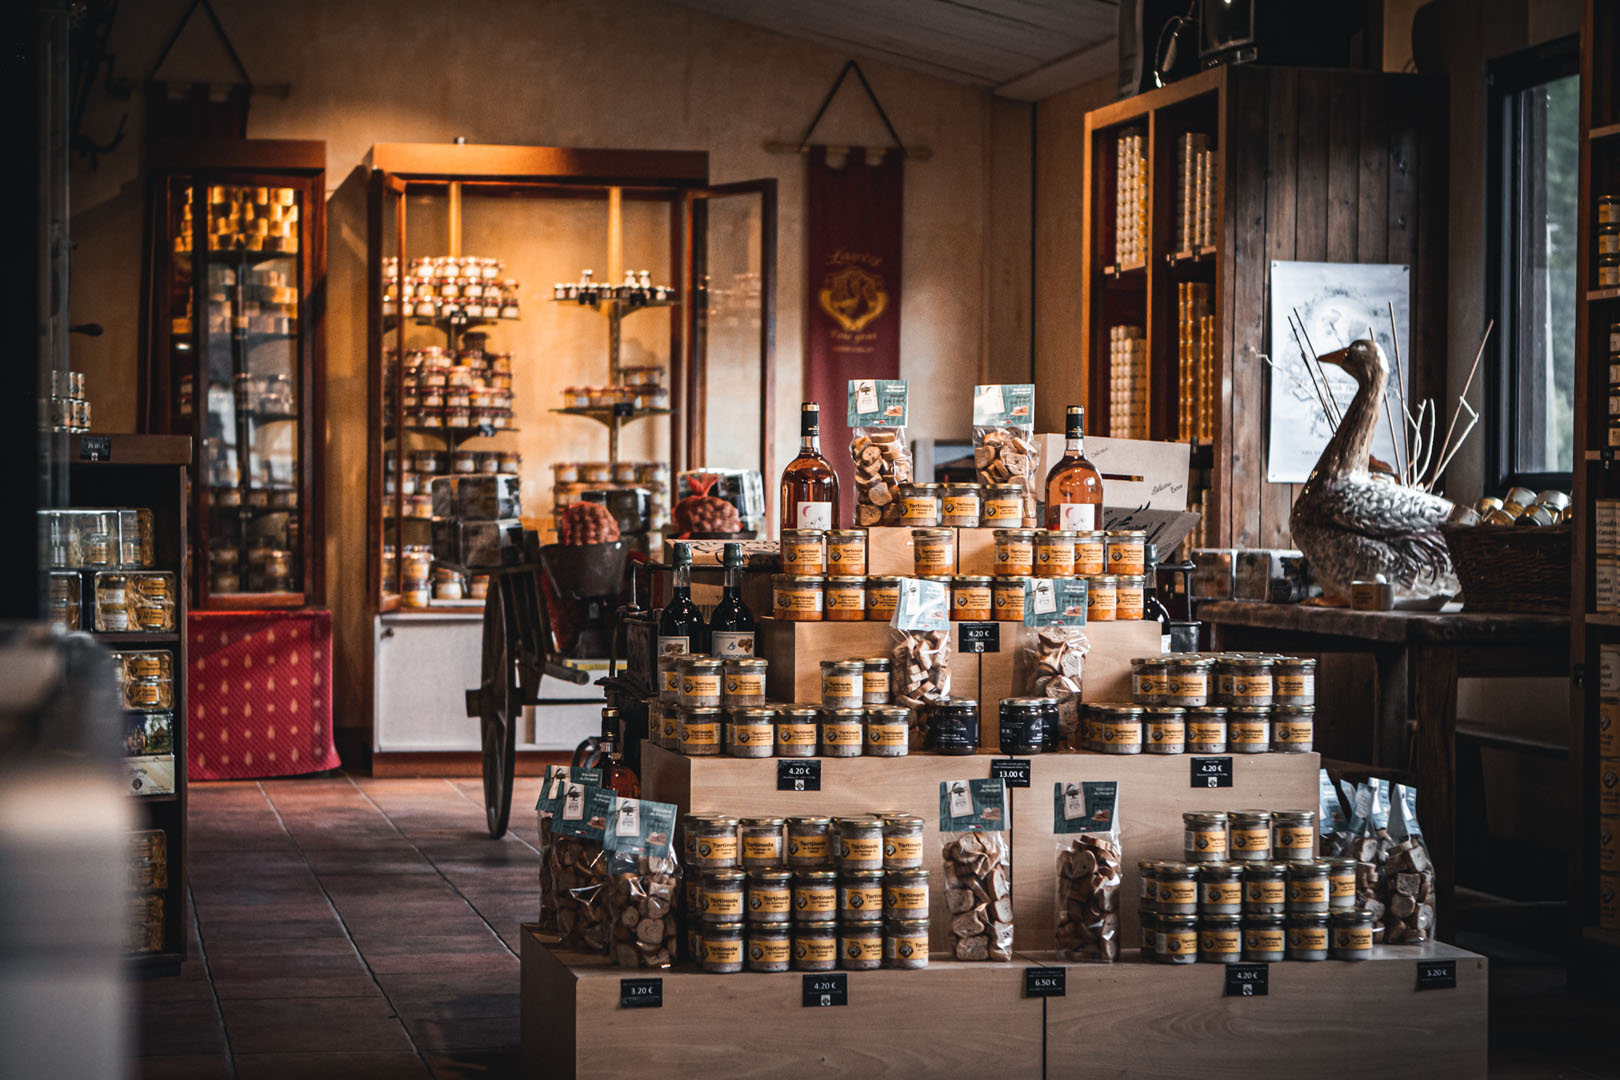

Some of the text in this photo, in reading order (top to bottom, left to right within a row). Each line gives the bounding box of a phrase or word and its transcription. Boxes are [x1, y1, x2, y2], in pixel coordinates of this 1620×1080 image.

[788, 767, 811, 775] 4.20 €
[999, 770, 1024, 778] 13.00 €
[1236, 971, 1258, 979] 4.20 €
[1426, 969, 1442, 977] 3.20
[813, 982, 836, 990] 4.20 €
[1035, 978, 1057, 987] 6.50 €
[631, 986, 647, 995] 3.20
